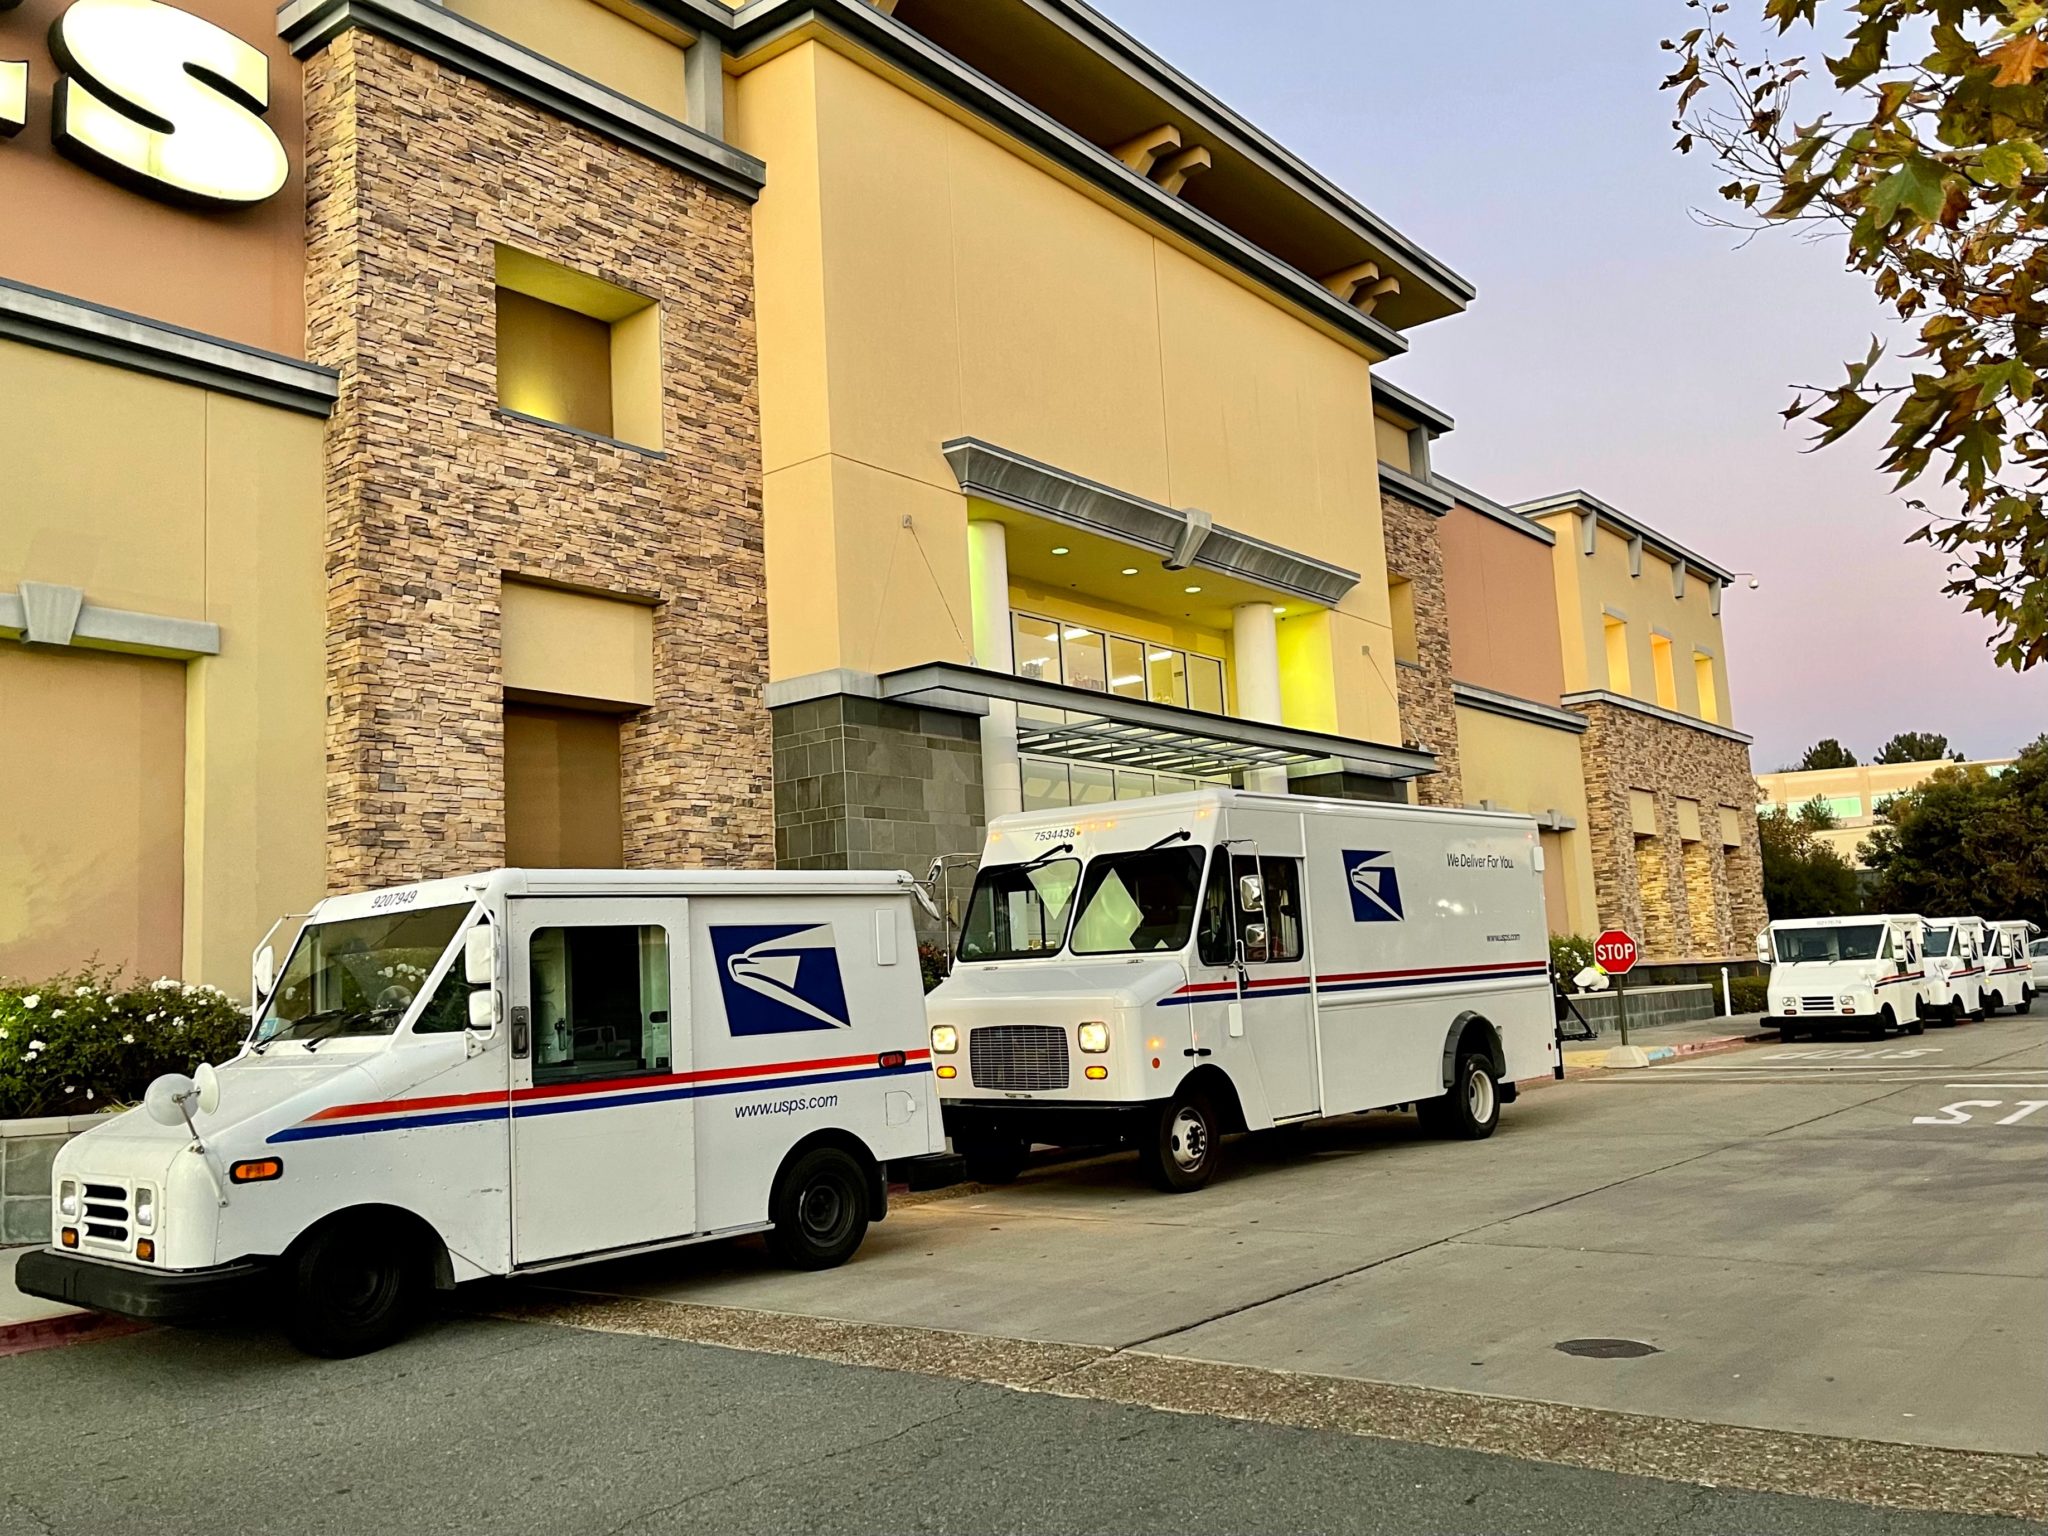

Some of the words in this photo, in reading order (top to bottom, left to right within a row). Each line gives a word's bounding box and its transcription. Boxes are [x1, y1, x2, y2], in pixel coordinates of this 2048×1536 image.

[1034, 828, 1076, 841] 7534438
[1446, 852, 1460, 867] We
[1460, 853, 1486, 868] Deliver
[1487, 854, 1500, 868] For
[371, 889, 418, 909] 9207949
[1597, 943, 1634, 961] STOP
[735, 1094, 838, 1119] www.usps.com
